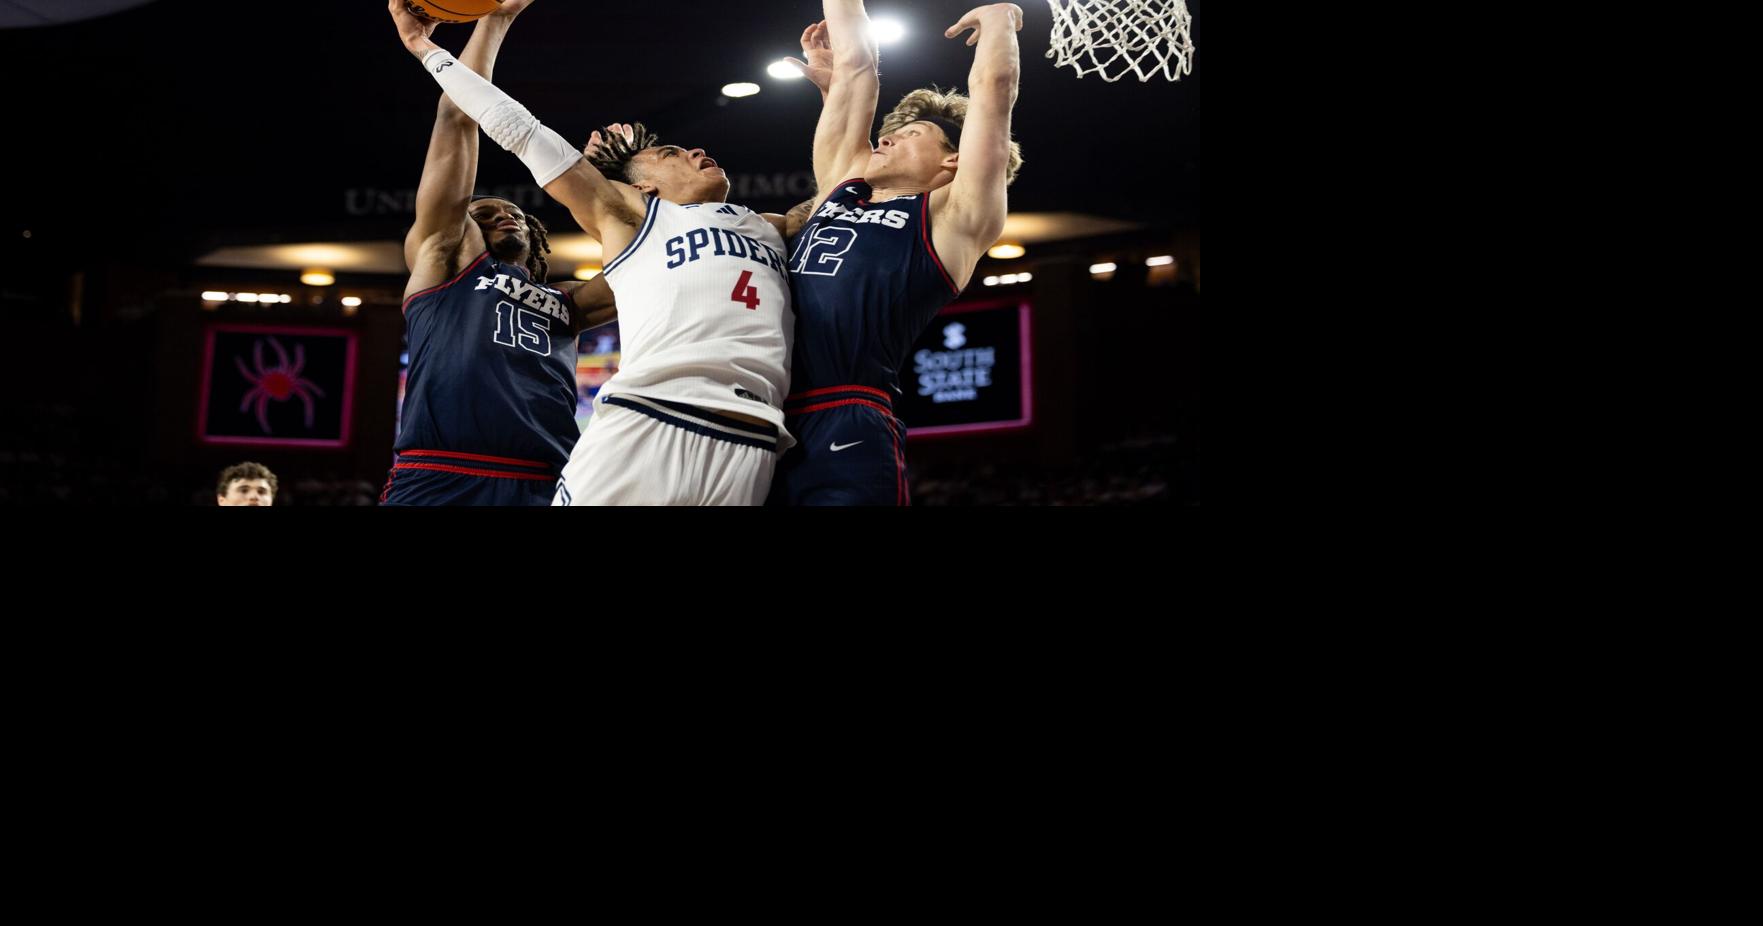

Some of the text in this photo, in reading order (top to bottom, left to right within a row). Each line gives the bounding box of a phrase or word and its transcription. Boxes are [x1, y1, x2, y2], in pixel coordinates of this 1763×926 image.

[789, 222, 858, 277] 12
[474, 273, 570, 327] FLYERS
[730, 270, 760, 310] 4
[493, 300, 551, 357] 15
[918, 368, 992, 396] STATE
